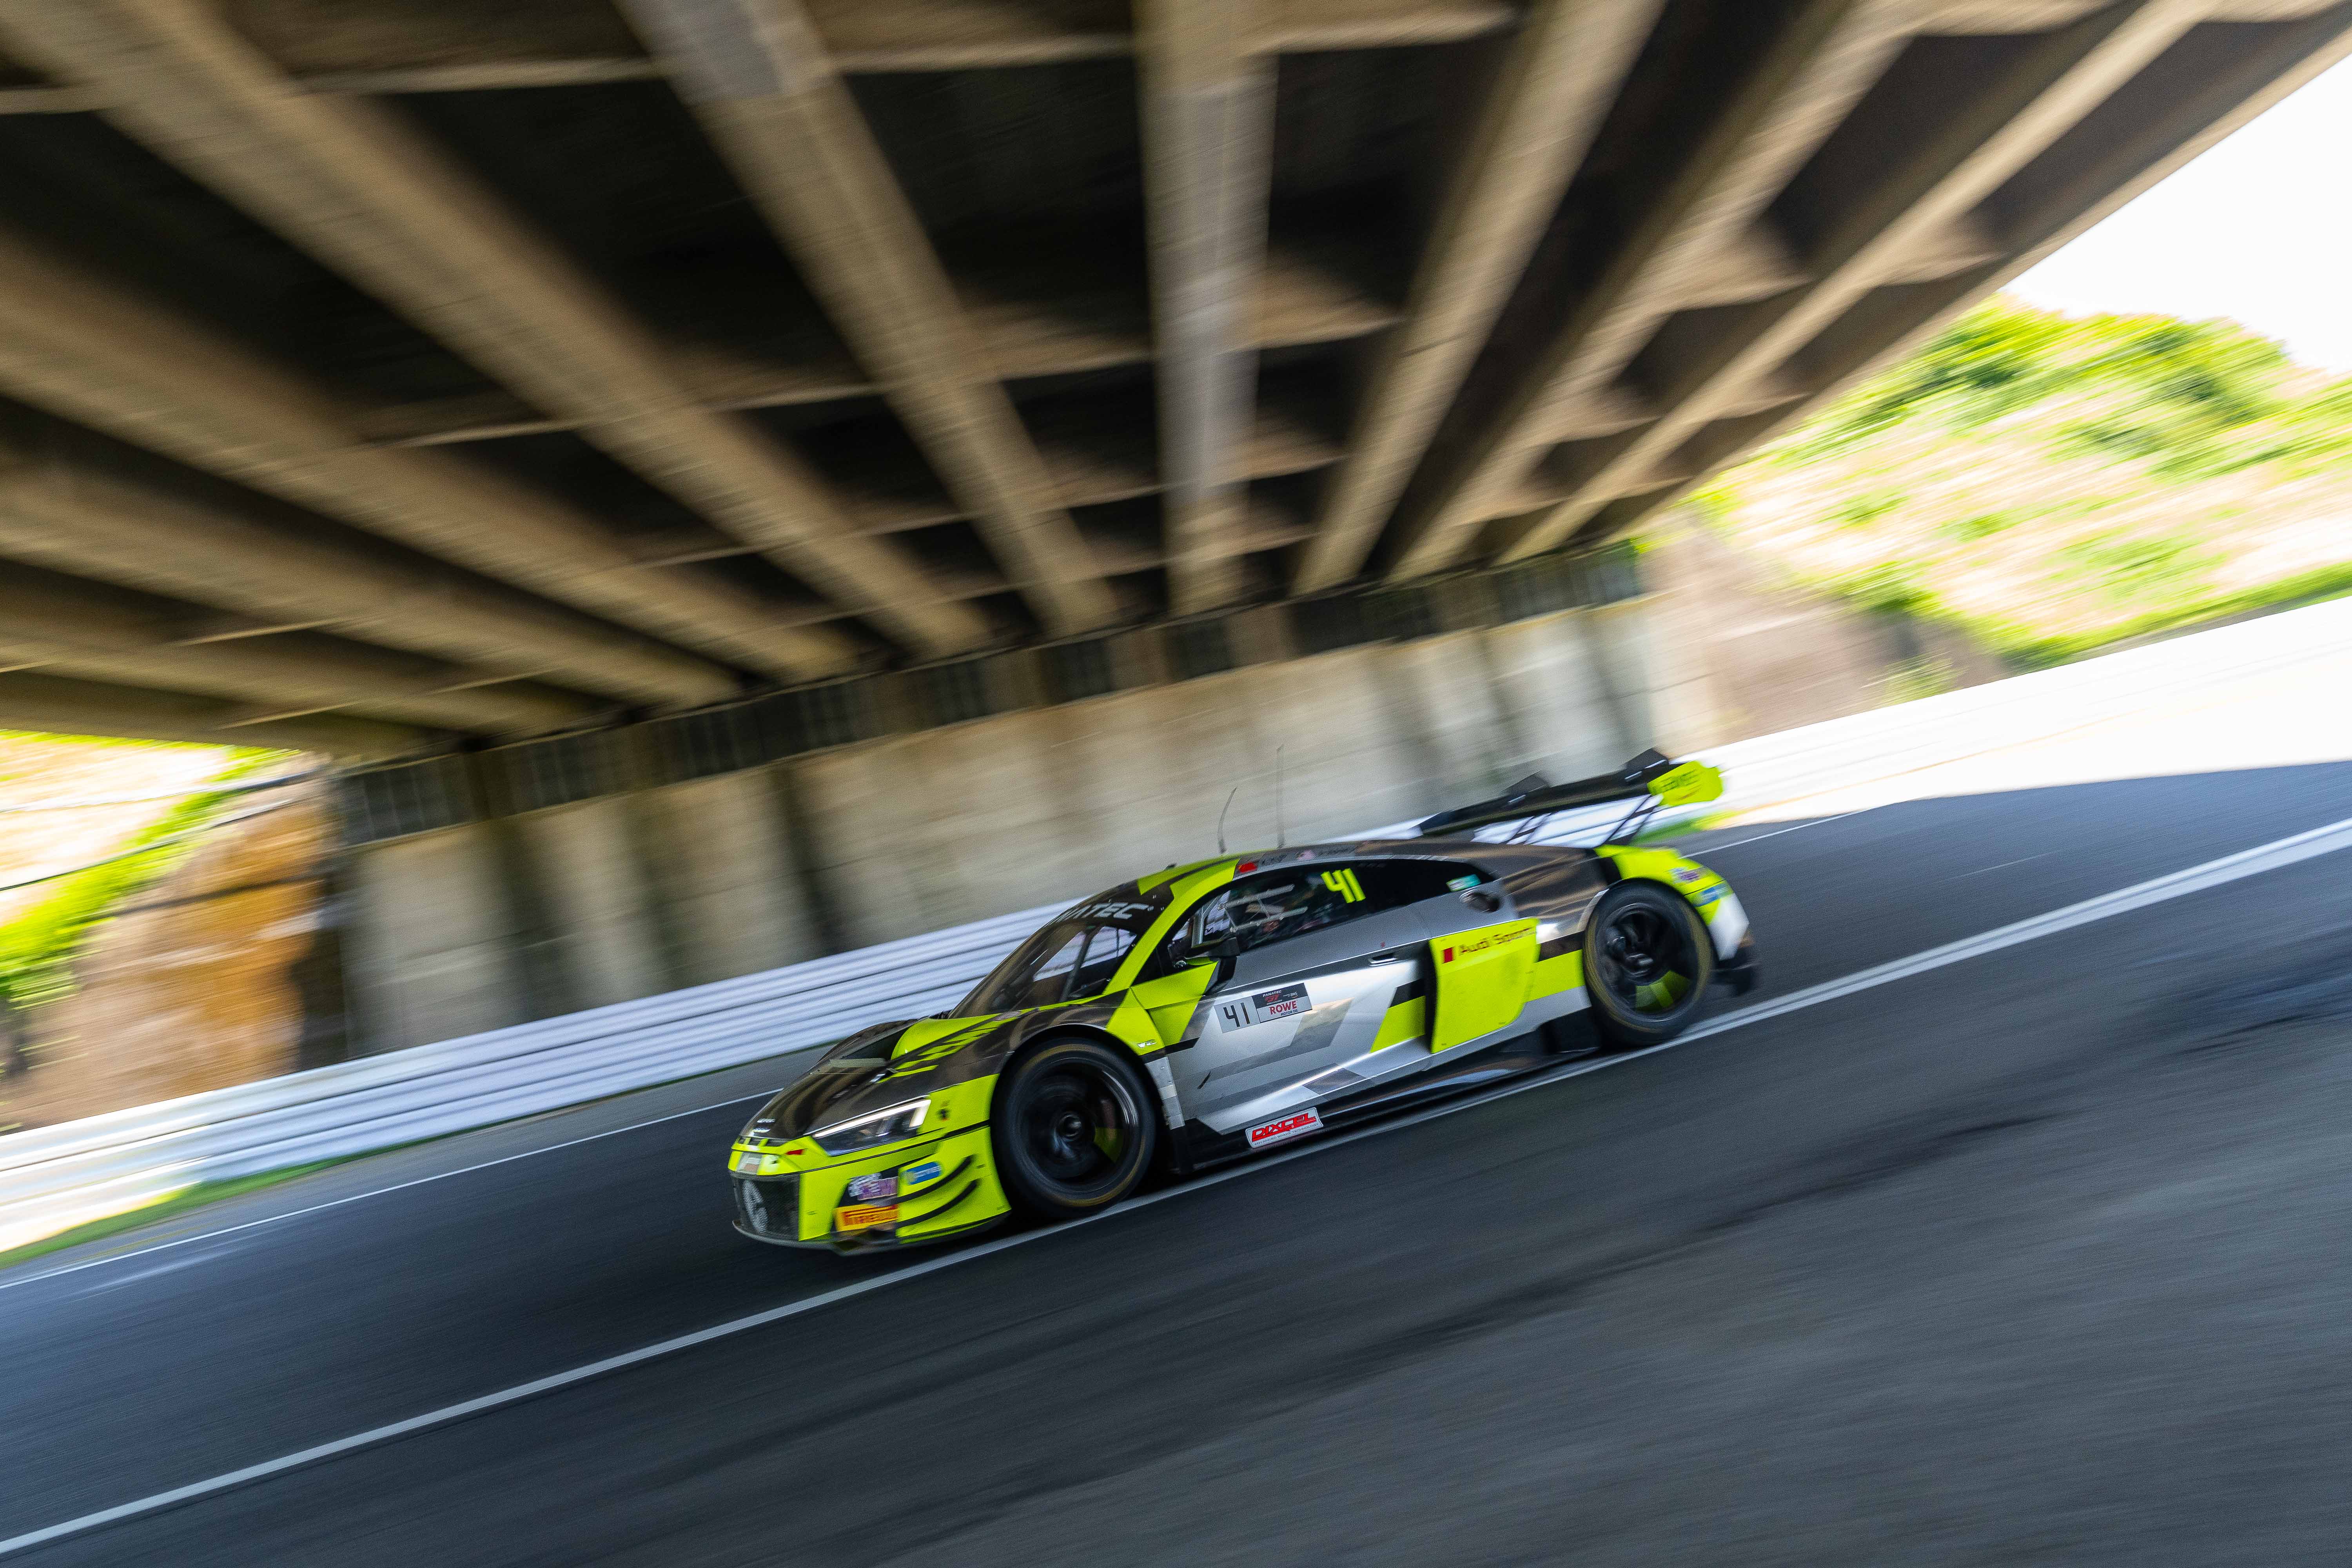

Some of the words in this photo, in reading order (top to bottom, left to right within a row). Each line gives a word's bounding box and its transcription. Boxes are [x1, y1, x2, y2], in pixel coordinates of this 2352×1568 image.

[1321, 868, 1366, 903] 41
[1458, 937, 1490, 956] Audi
[1223, 1002, 1250, 1027] 41
[1269, 1000, 1297, 1015] ROWE
[1252, 1113, 1316, 1142] DIXCEL
